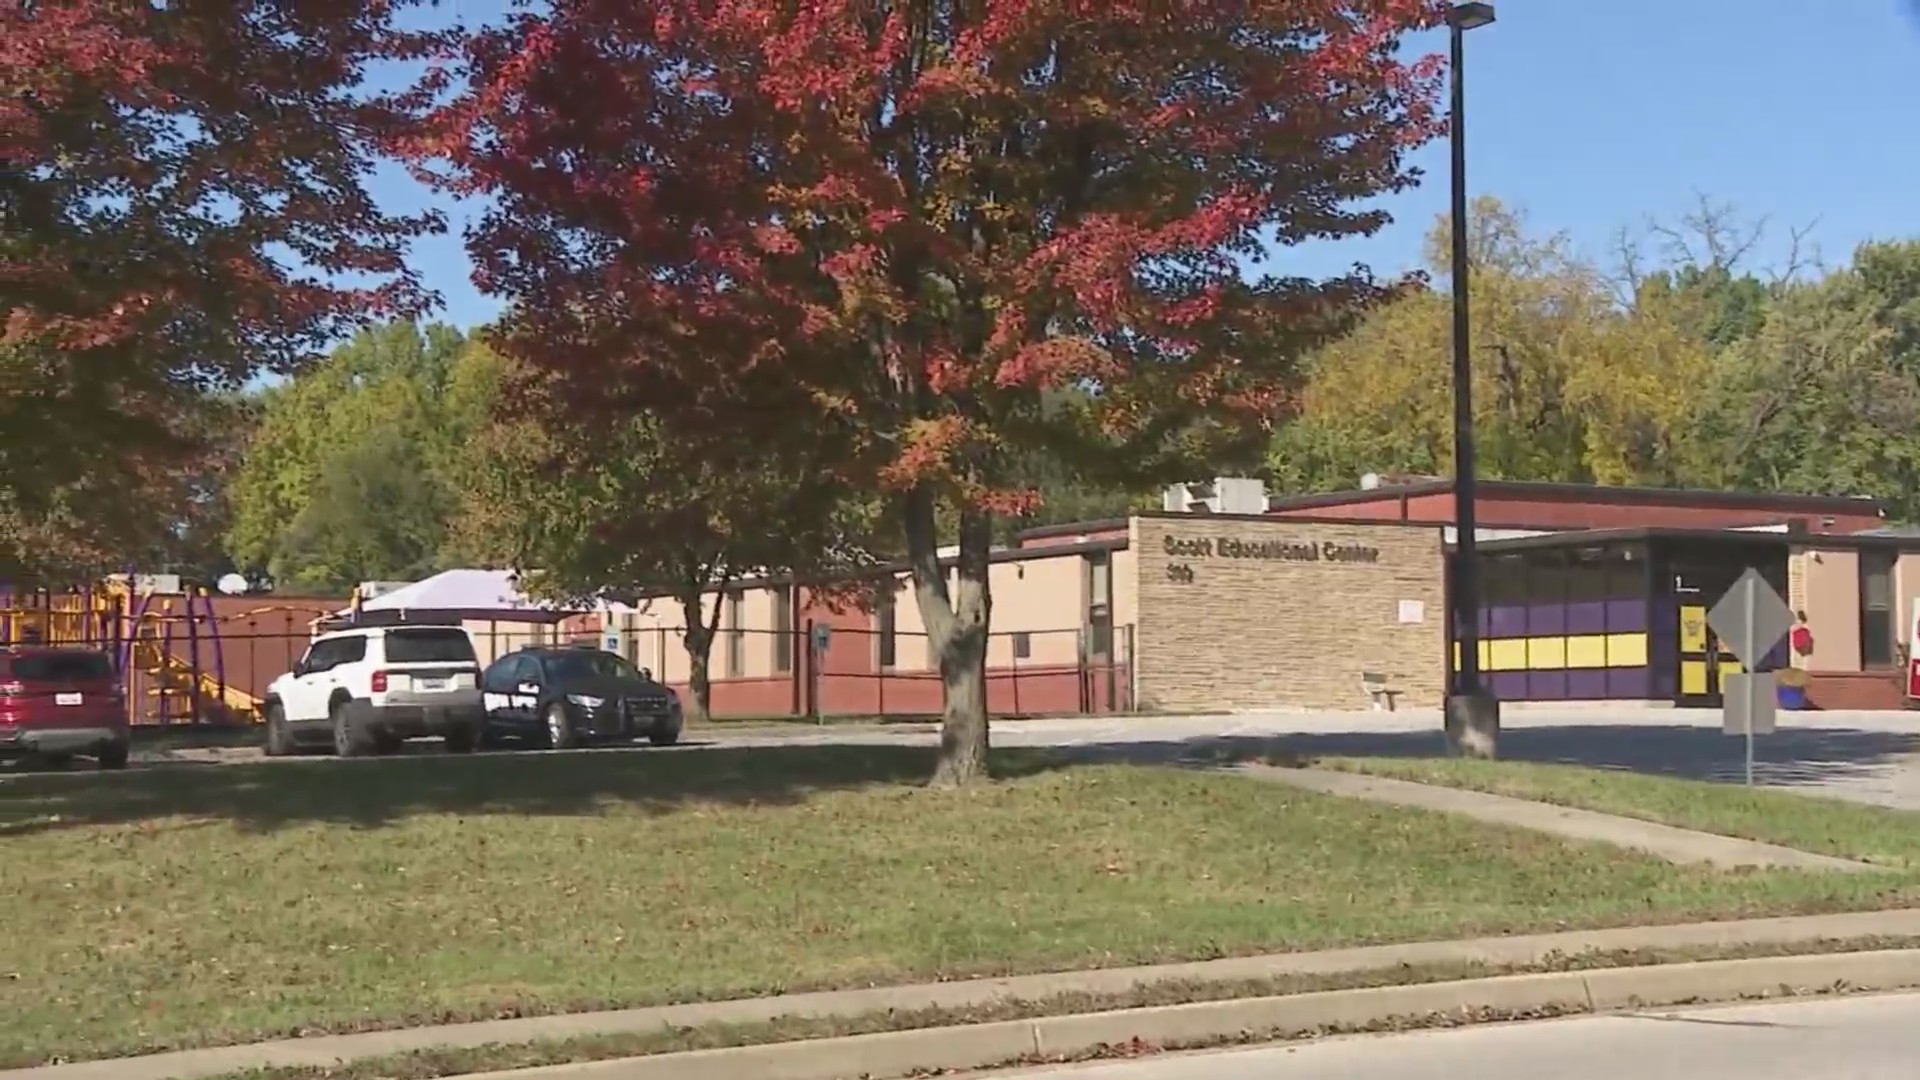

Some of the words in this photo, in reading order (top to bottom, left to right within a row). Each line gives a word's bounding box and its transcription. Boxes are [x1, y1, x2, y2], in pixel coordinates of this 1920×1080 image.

[1163, 534, 1212, 557] Scott
[1217, 536, 1319, 561] Educational
[1323, 541, 1379, 563] Center
